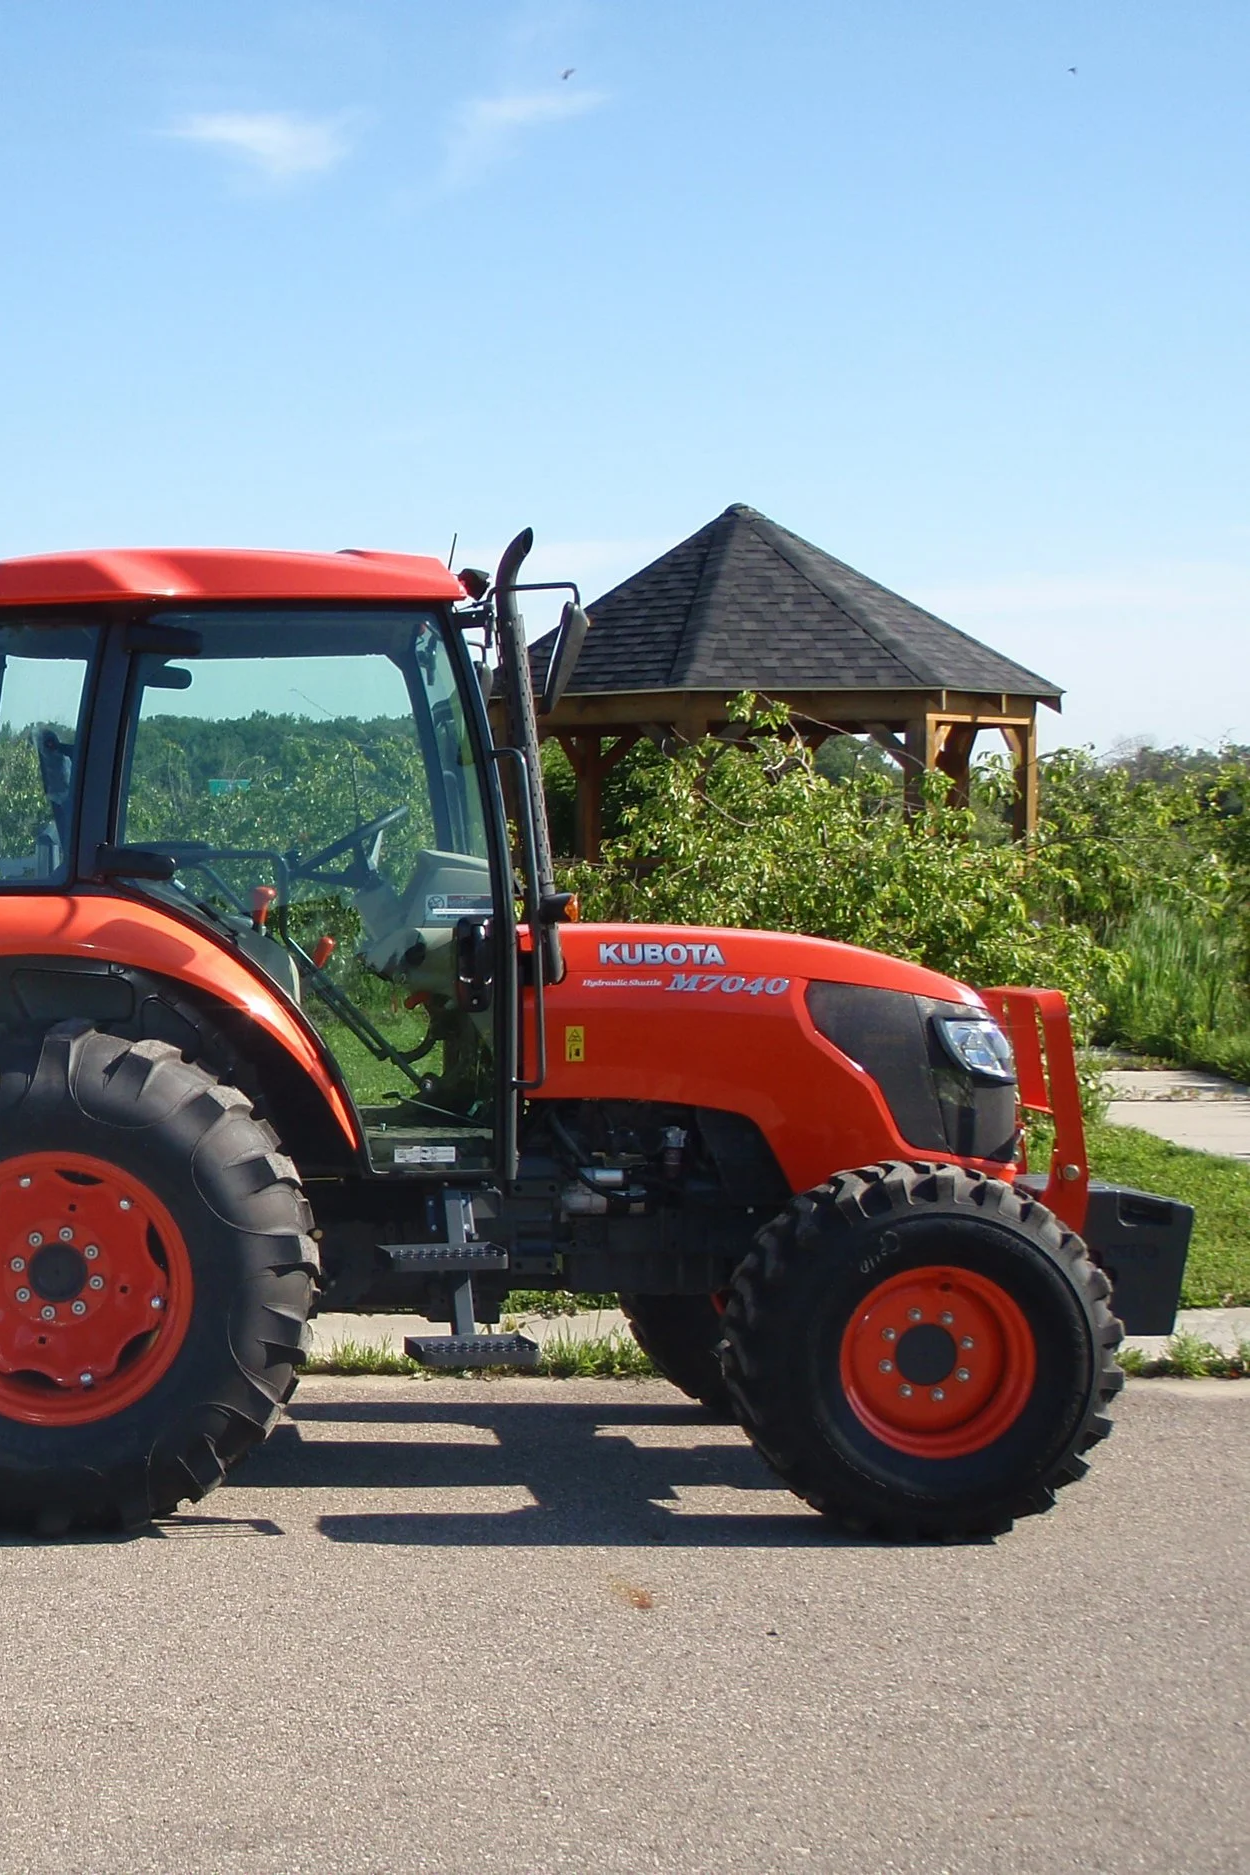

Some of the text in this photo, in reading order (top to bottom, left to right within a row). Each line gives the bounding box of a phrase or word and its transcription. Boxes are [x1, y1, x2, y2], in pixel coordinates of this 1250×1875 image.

[599, 943, 725, 965] KUBOTA
[582, 979, 627, 987] Hydraulic
[665, 974, 789, 995] M7040
